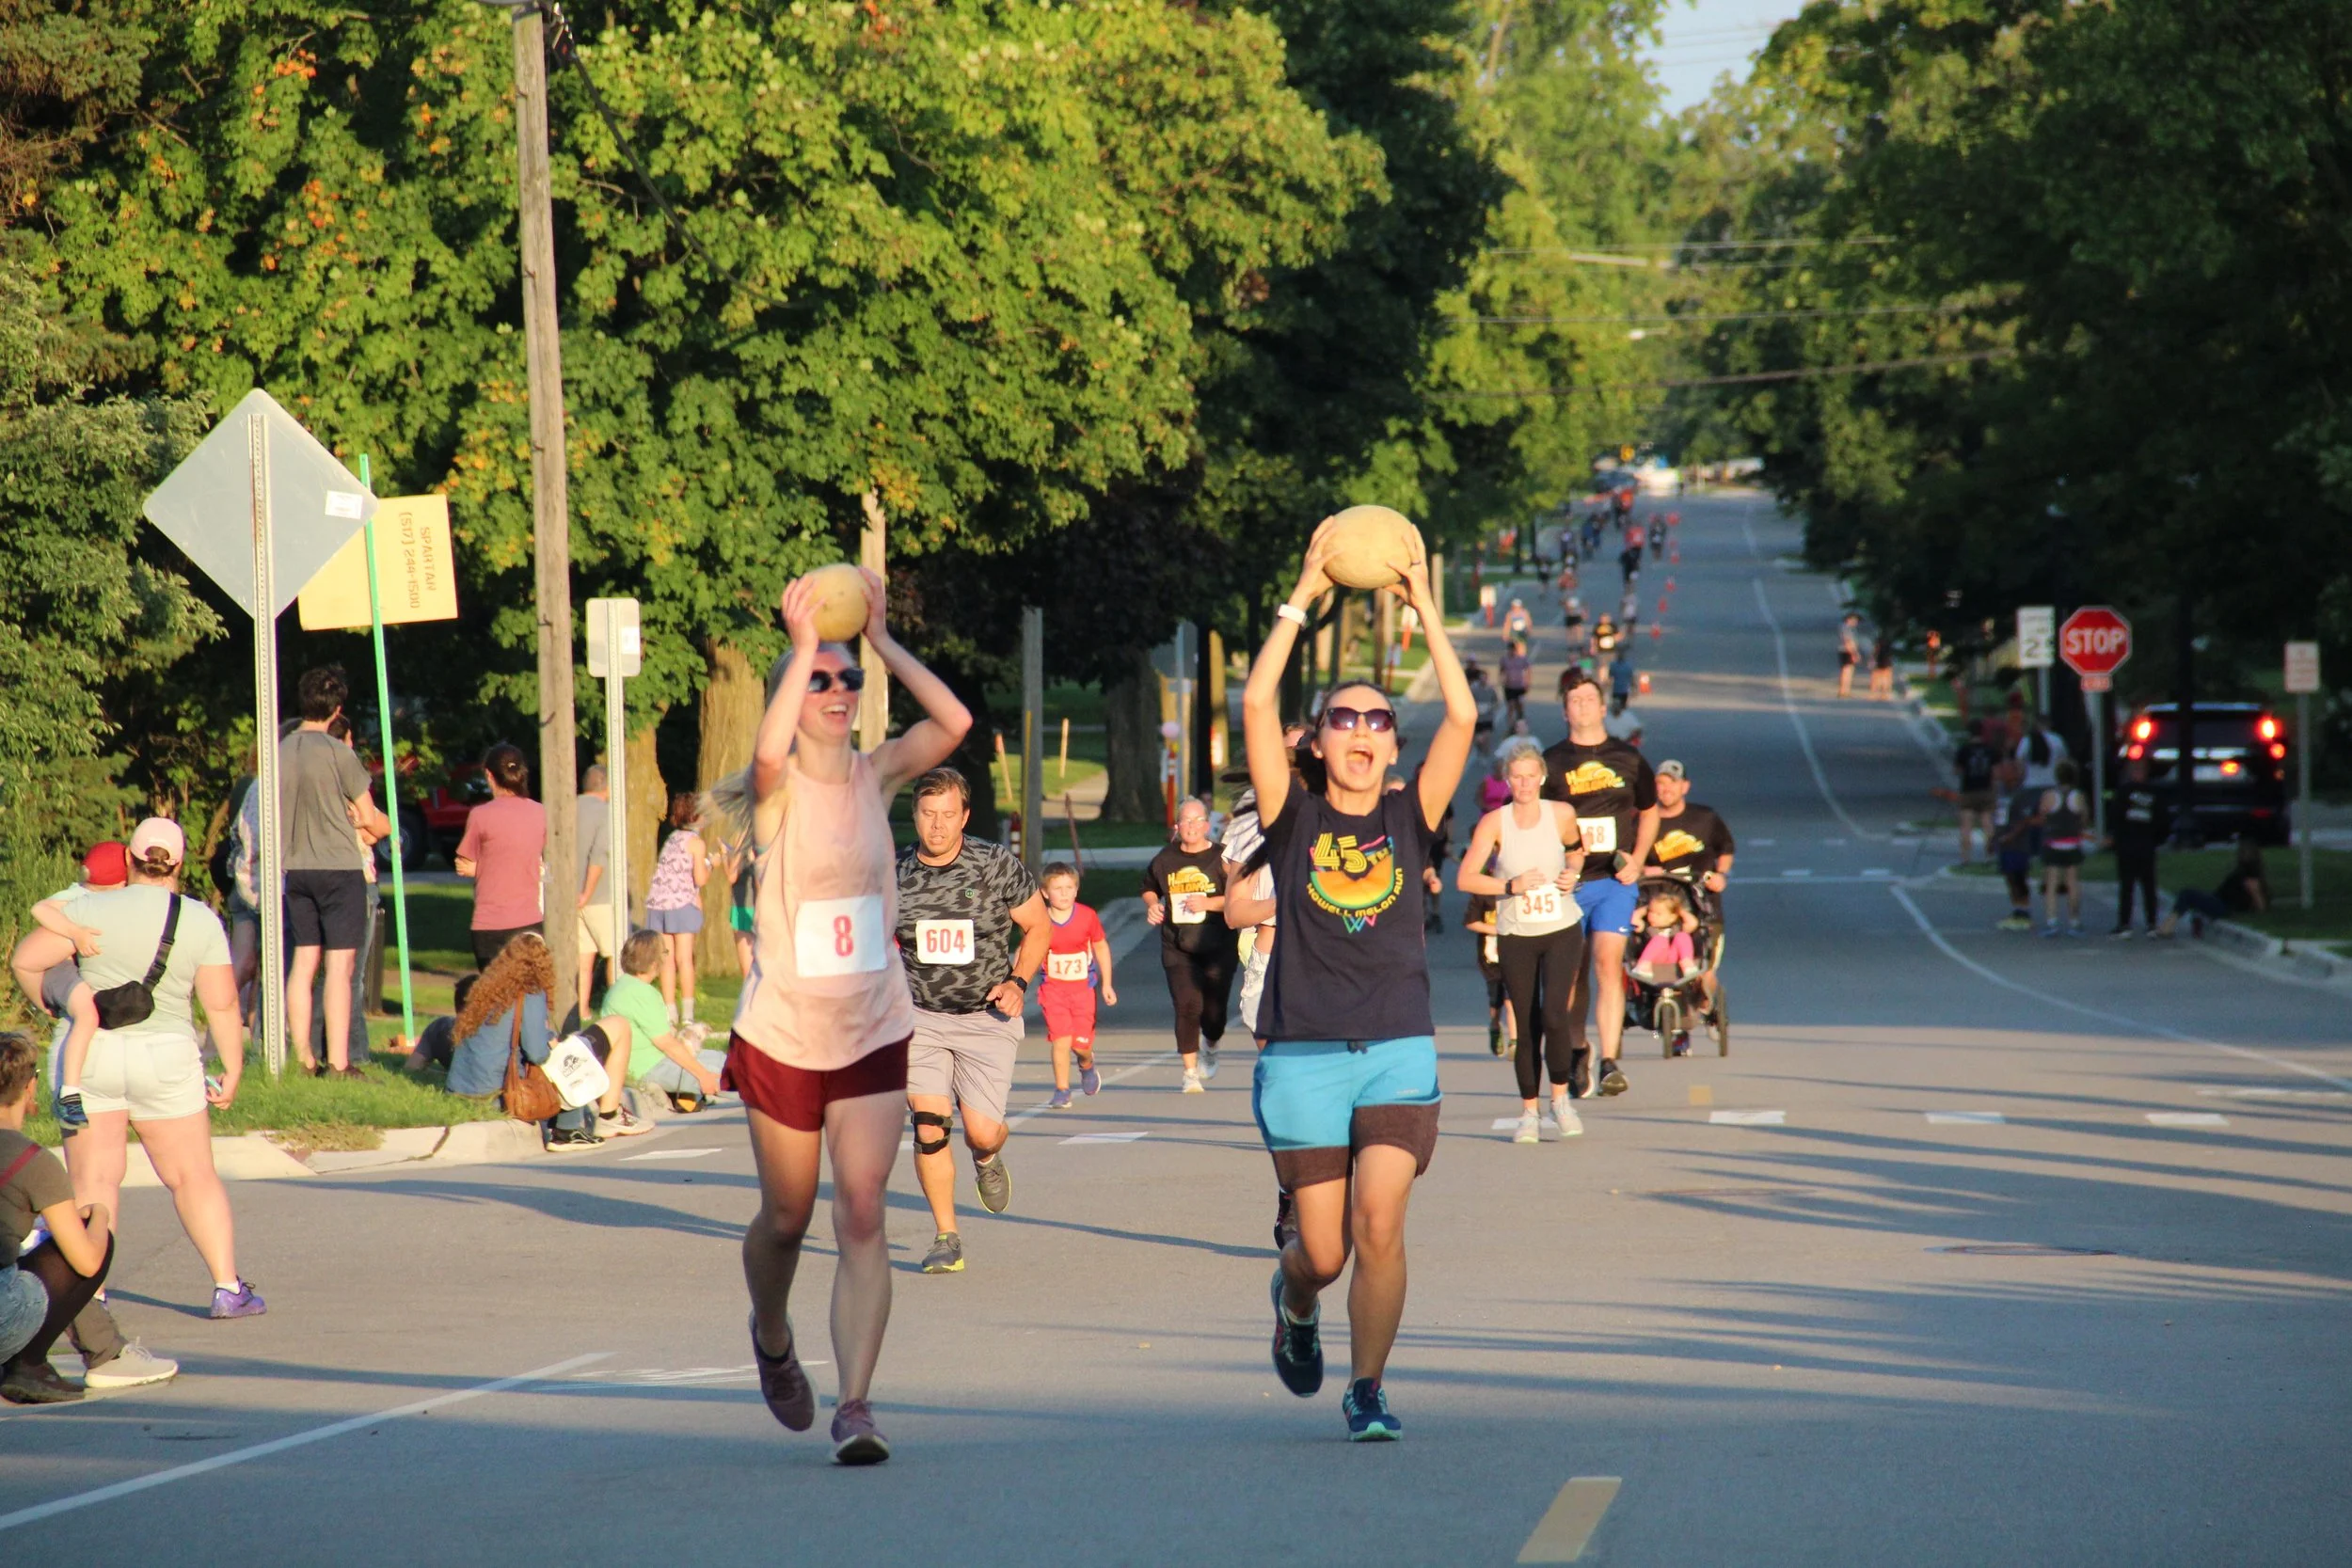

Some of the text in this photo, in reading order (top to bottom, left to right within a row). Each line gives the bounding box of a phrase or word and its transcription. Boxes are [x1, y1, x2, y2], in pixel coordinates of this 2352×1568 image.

[421, 527, 436, 591] SPARTAN
[2066, 628, 2125, 655] STOP
[1307, 867, 1404, 917] HOWELL MELON RUN
[1521, 893, 1553, 915] 345
[833, 914, 854, 958] 8
[925, 927, 966, 954] 604
[1054, 958, 1082, 974] 173
